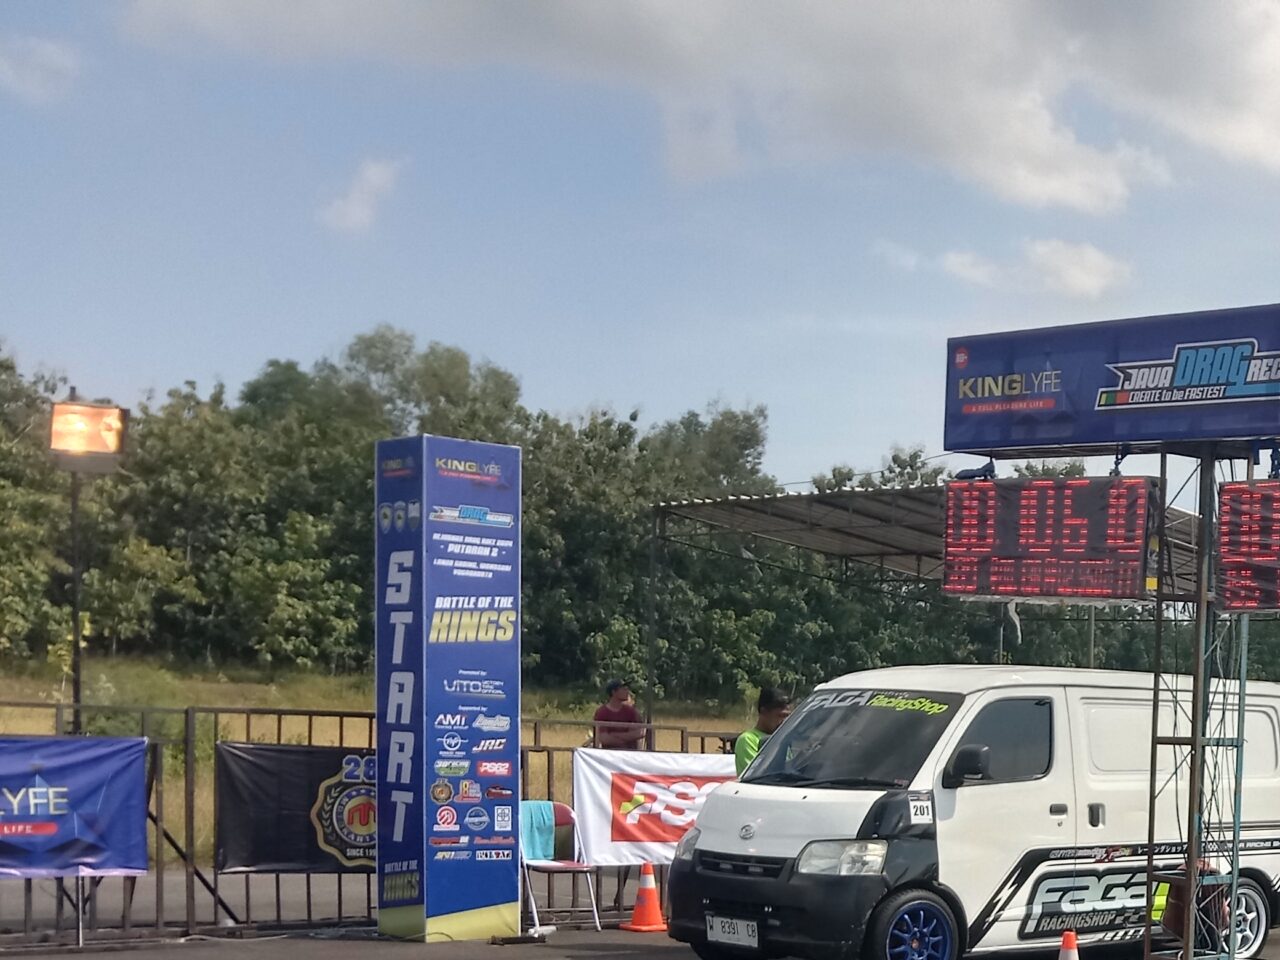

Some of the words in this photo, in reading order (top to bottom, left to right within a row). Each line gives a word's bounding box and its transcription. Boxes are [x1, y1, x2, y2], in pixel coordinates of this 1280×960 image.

[1124, 366, 1174, 390] JAVA
[1174, 344, 1254, 389] DRAG
[959, 370, 1062, 399] KINGLYFE
[1128, 390, 1160, 403] CREATE
[1160, 389, 1171, 401] to
[1171, 388, 1184, 401] be
[1184, 386, 1226, 400] FASTEST
[435, 596, 476, 608] BATTLE
[477, 597, 492, 608] OF
[494, 596, 514, 608] THE
[429, 610, 517, 643] KINGS
[385, 550, 415, 843] START
[866, 694, 948, 715] RacingShop
[620, 781, 722, 825] PS
[913, 805, 930, 816] 201
[4, 825, 32, 834] LIFE
[346, 848, 364, 857] SINCE
[1039, 910, 1116, 931] RACINGSHOP
